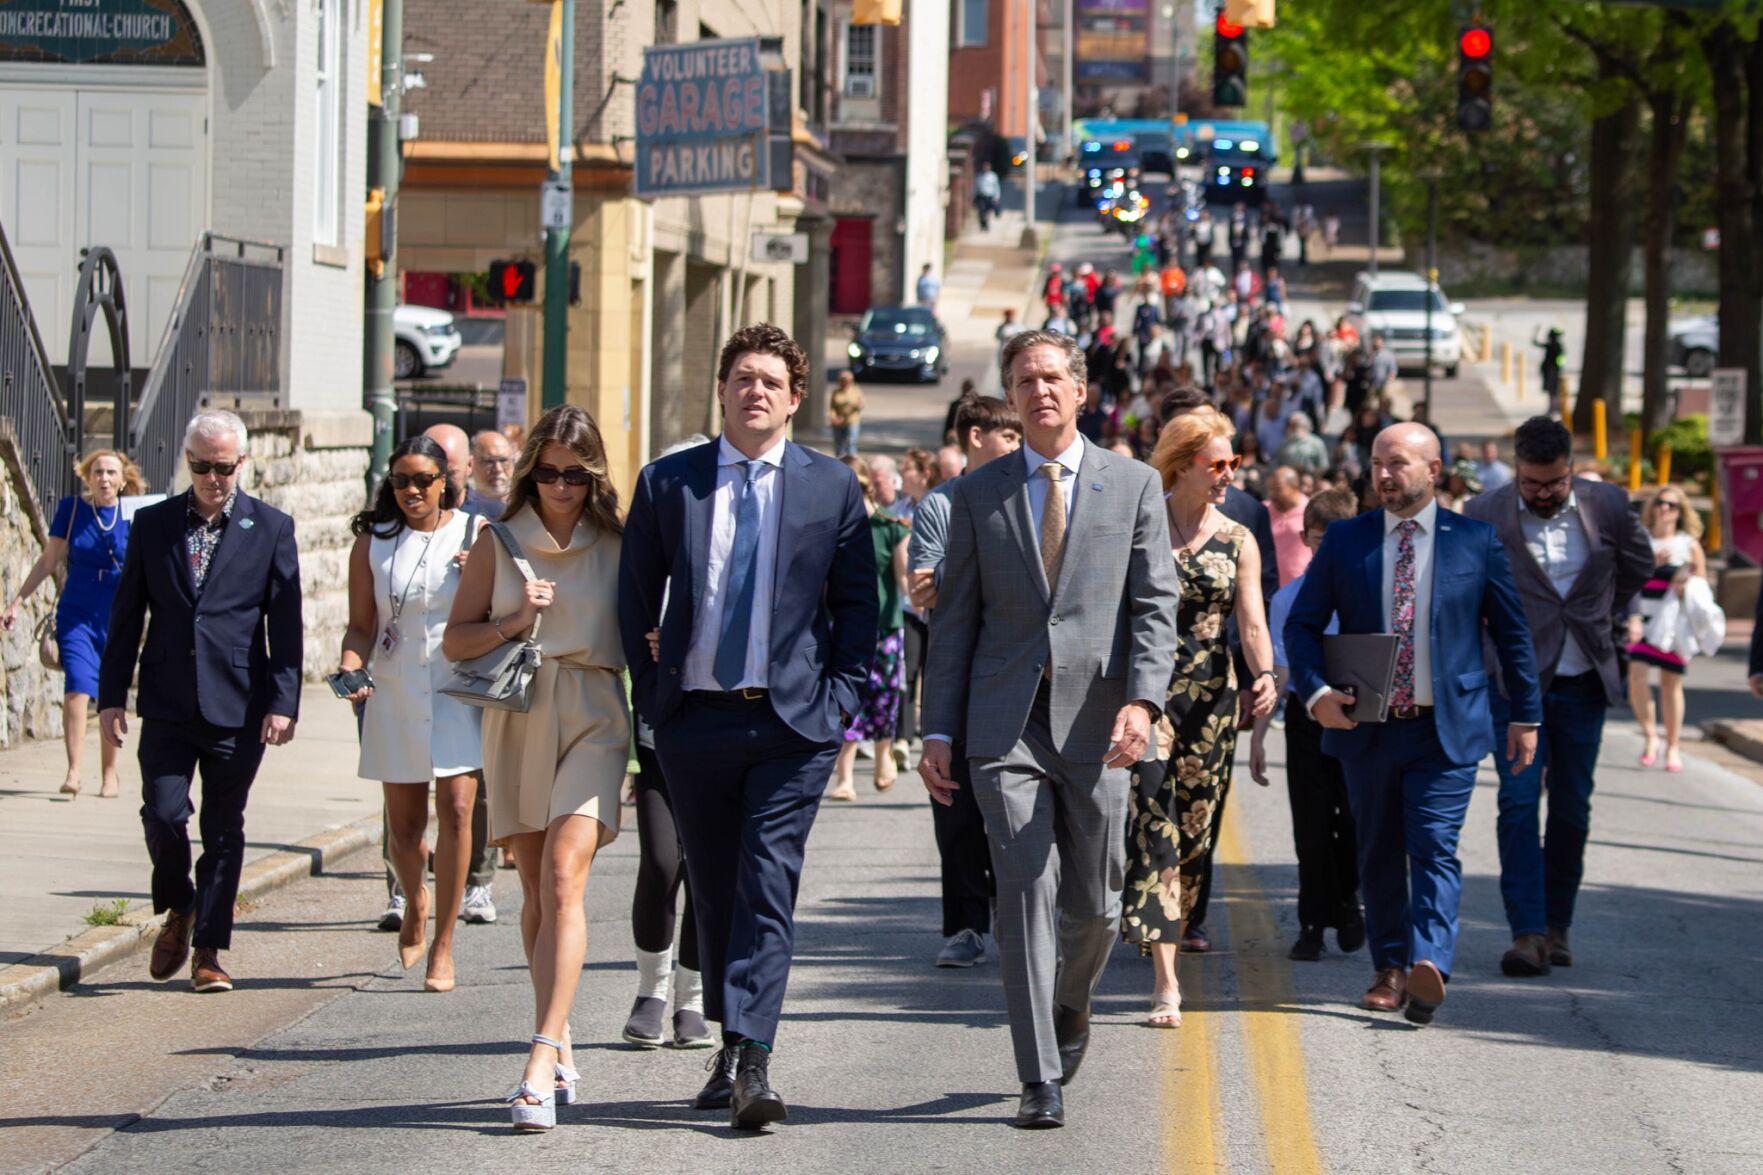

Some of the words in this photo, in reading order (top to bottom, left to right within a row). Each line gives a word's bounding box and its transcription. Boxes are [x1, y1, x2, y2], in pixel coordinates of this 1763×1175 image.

[113, 14, 170, 39] CHURCH
[651, 48, 750, 81] VOLUNTEER
[639, 77, 762, 135] GARAGE
[651, 142, 753, 185] PARKING
